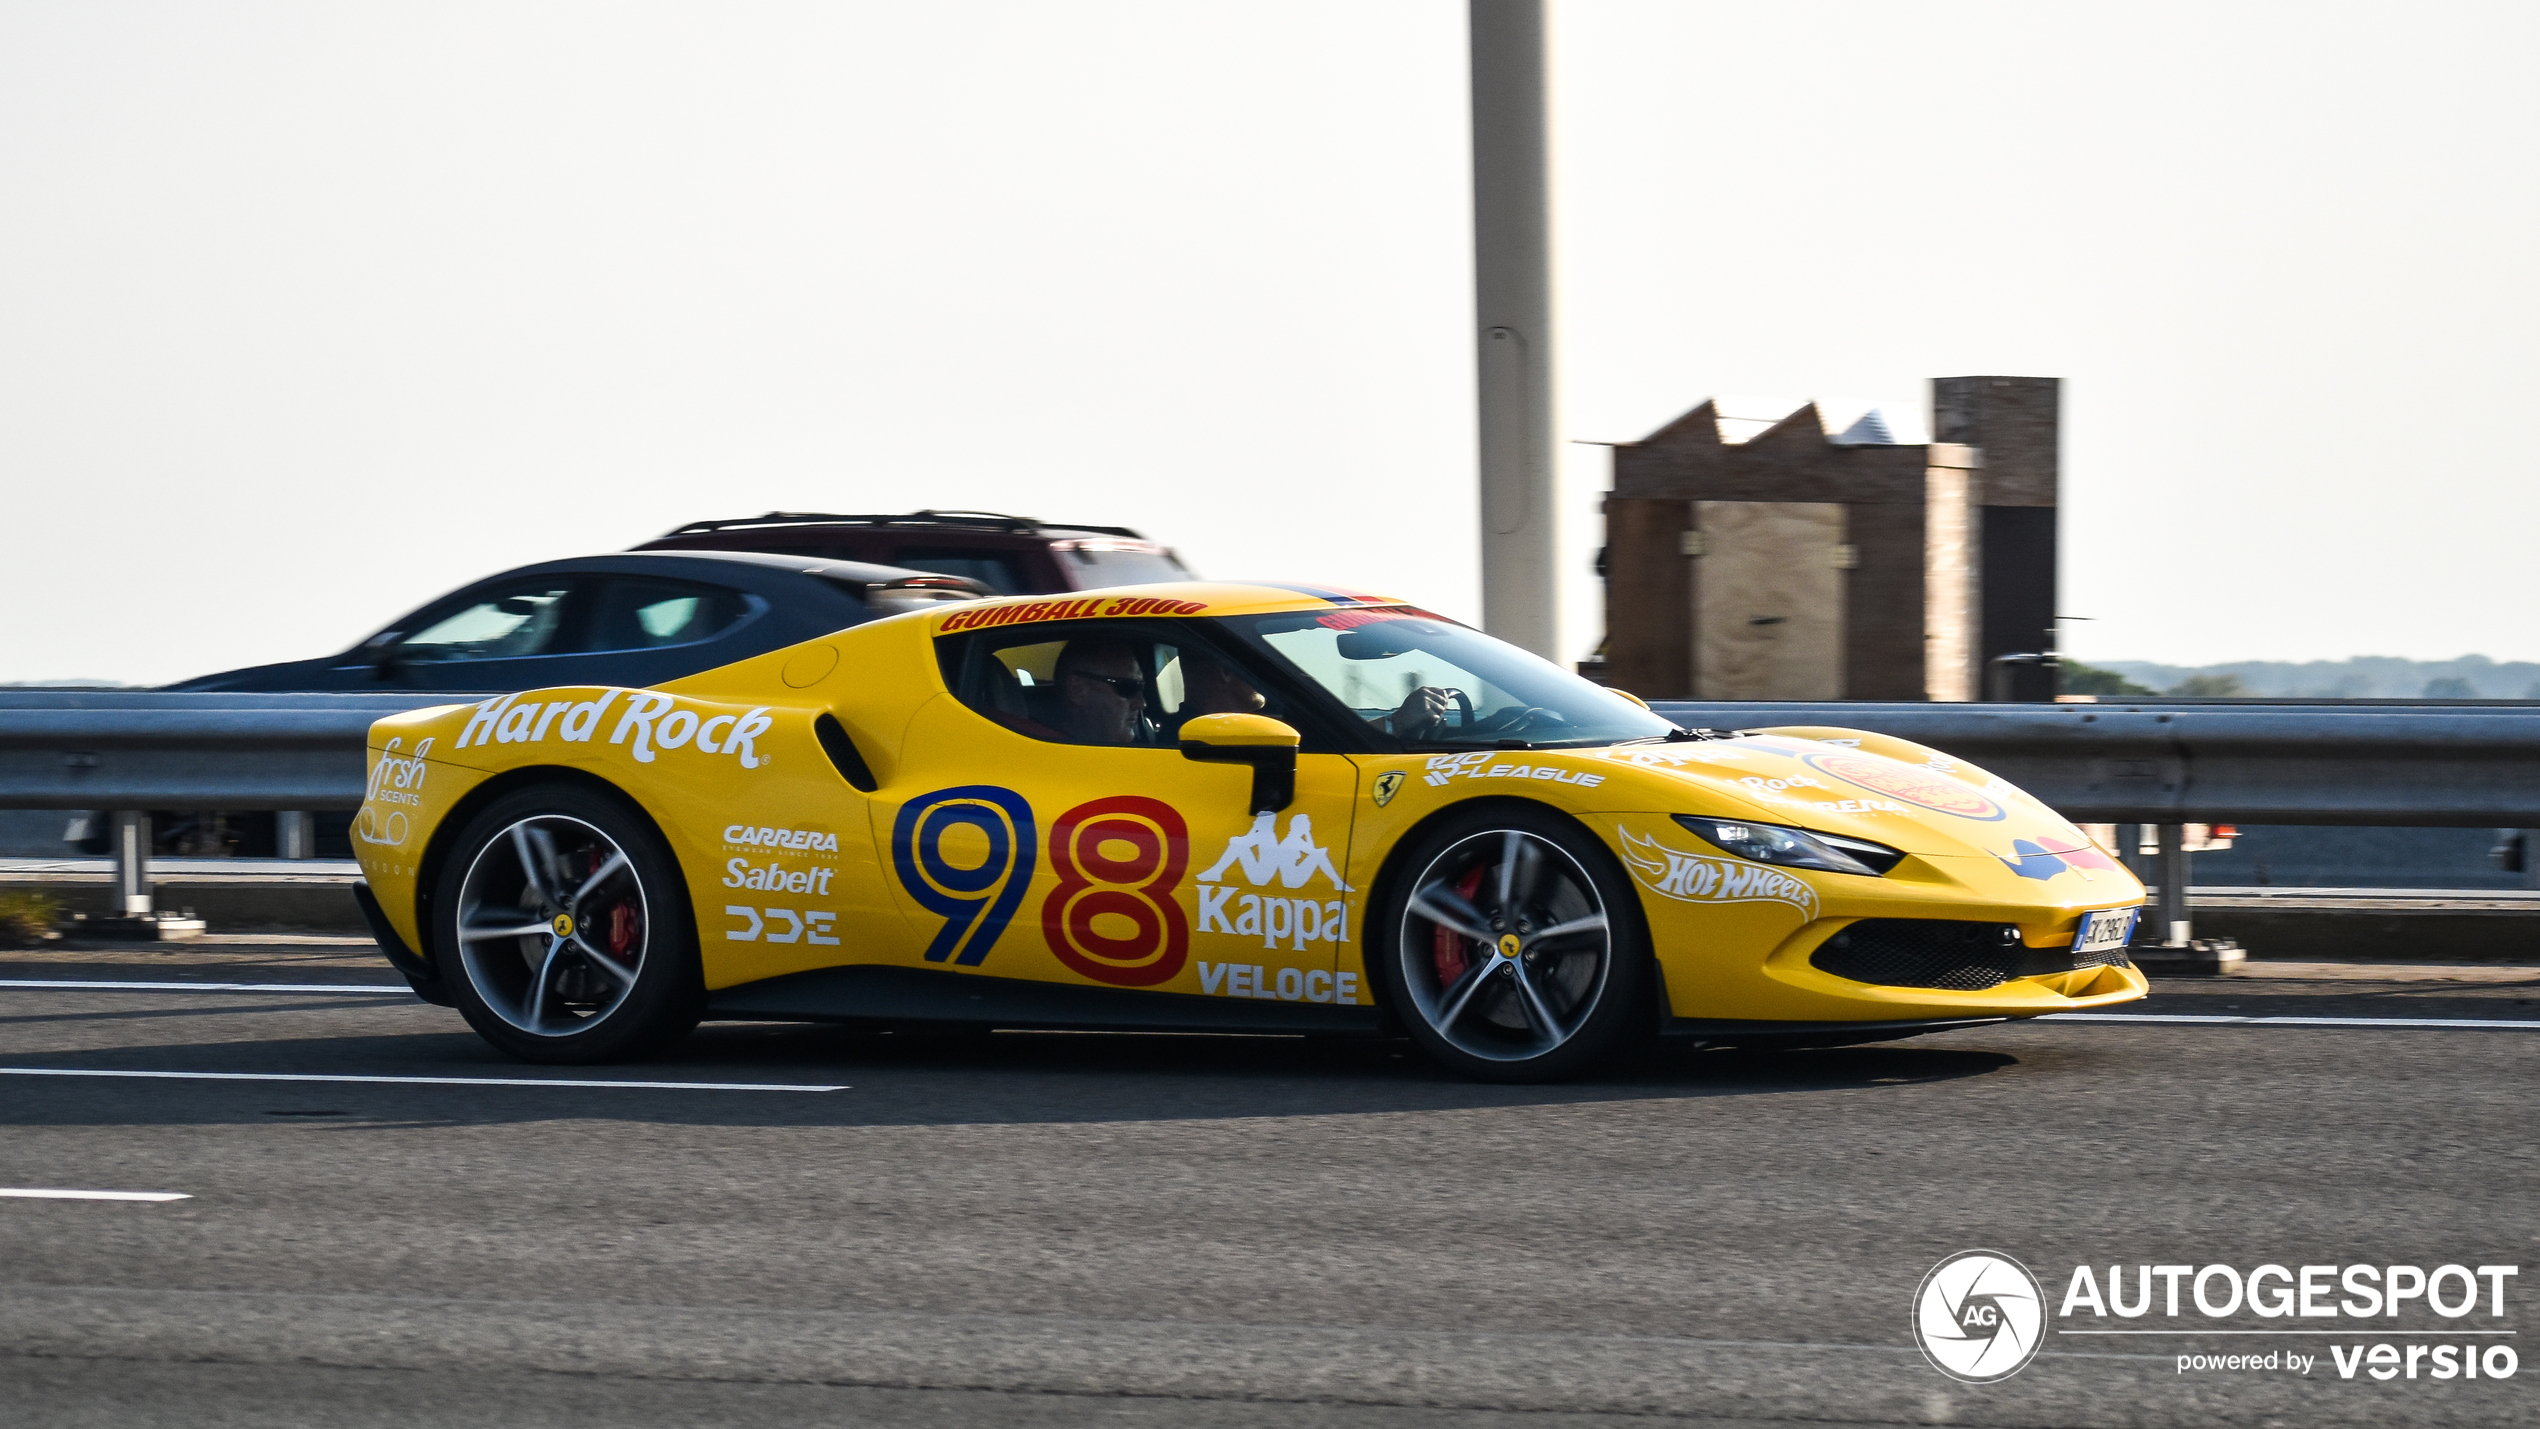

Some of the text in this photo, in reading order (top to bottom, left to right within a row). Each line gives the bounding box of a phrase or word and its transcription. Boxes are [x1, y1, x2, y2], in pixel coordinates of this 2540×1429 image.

[939, 598, 1208, 632] GUMBALL 3000
[455, 689, 772, 769] Hard Rock
[367, 736, 435, 801] frsh
[380, 789, 420, 806] SCENTS
[723, 825, 838, 852] CARRERA
[722, 857, 834, 896] Sabelt
[891, 784, 1190, 987] 98
[725, 905, 841, 946] DDE
[1195, 884, 1351, 951] Kappa
[1196, 961, 1358, 1005] VELOCE
